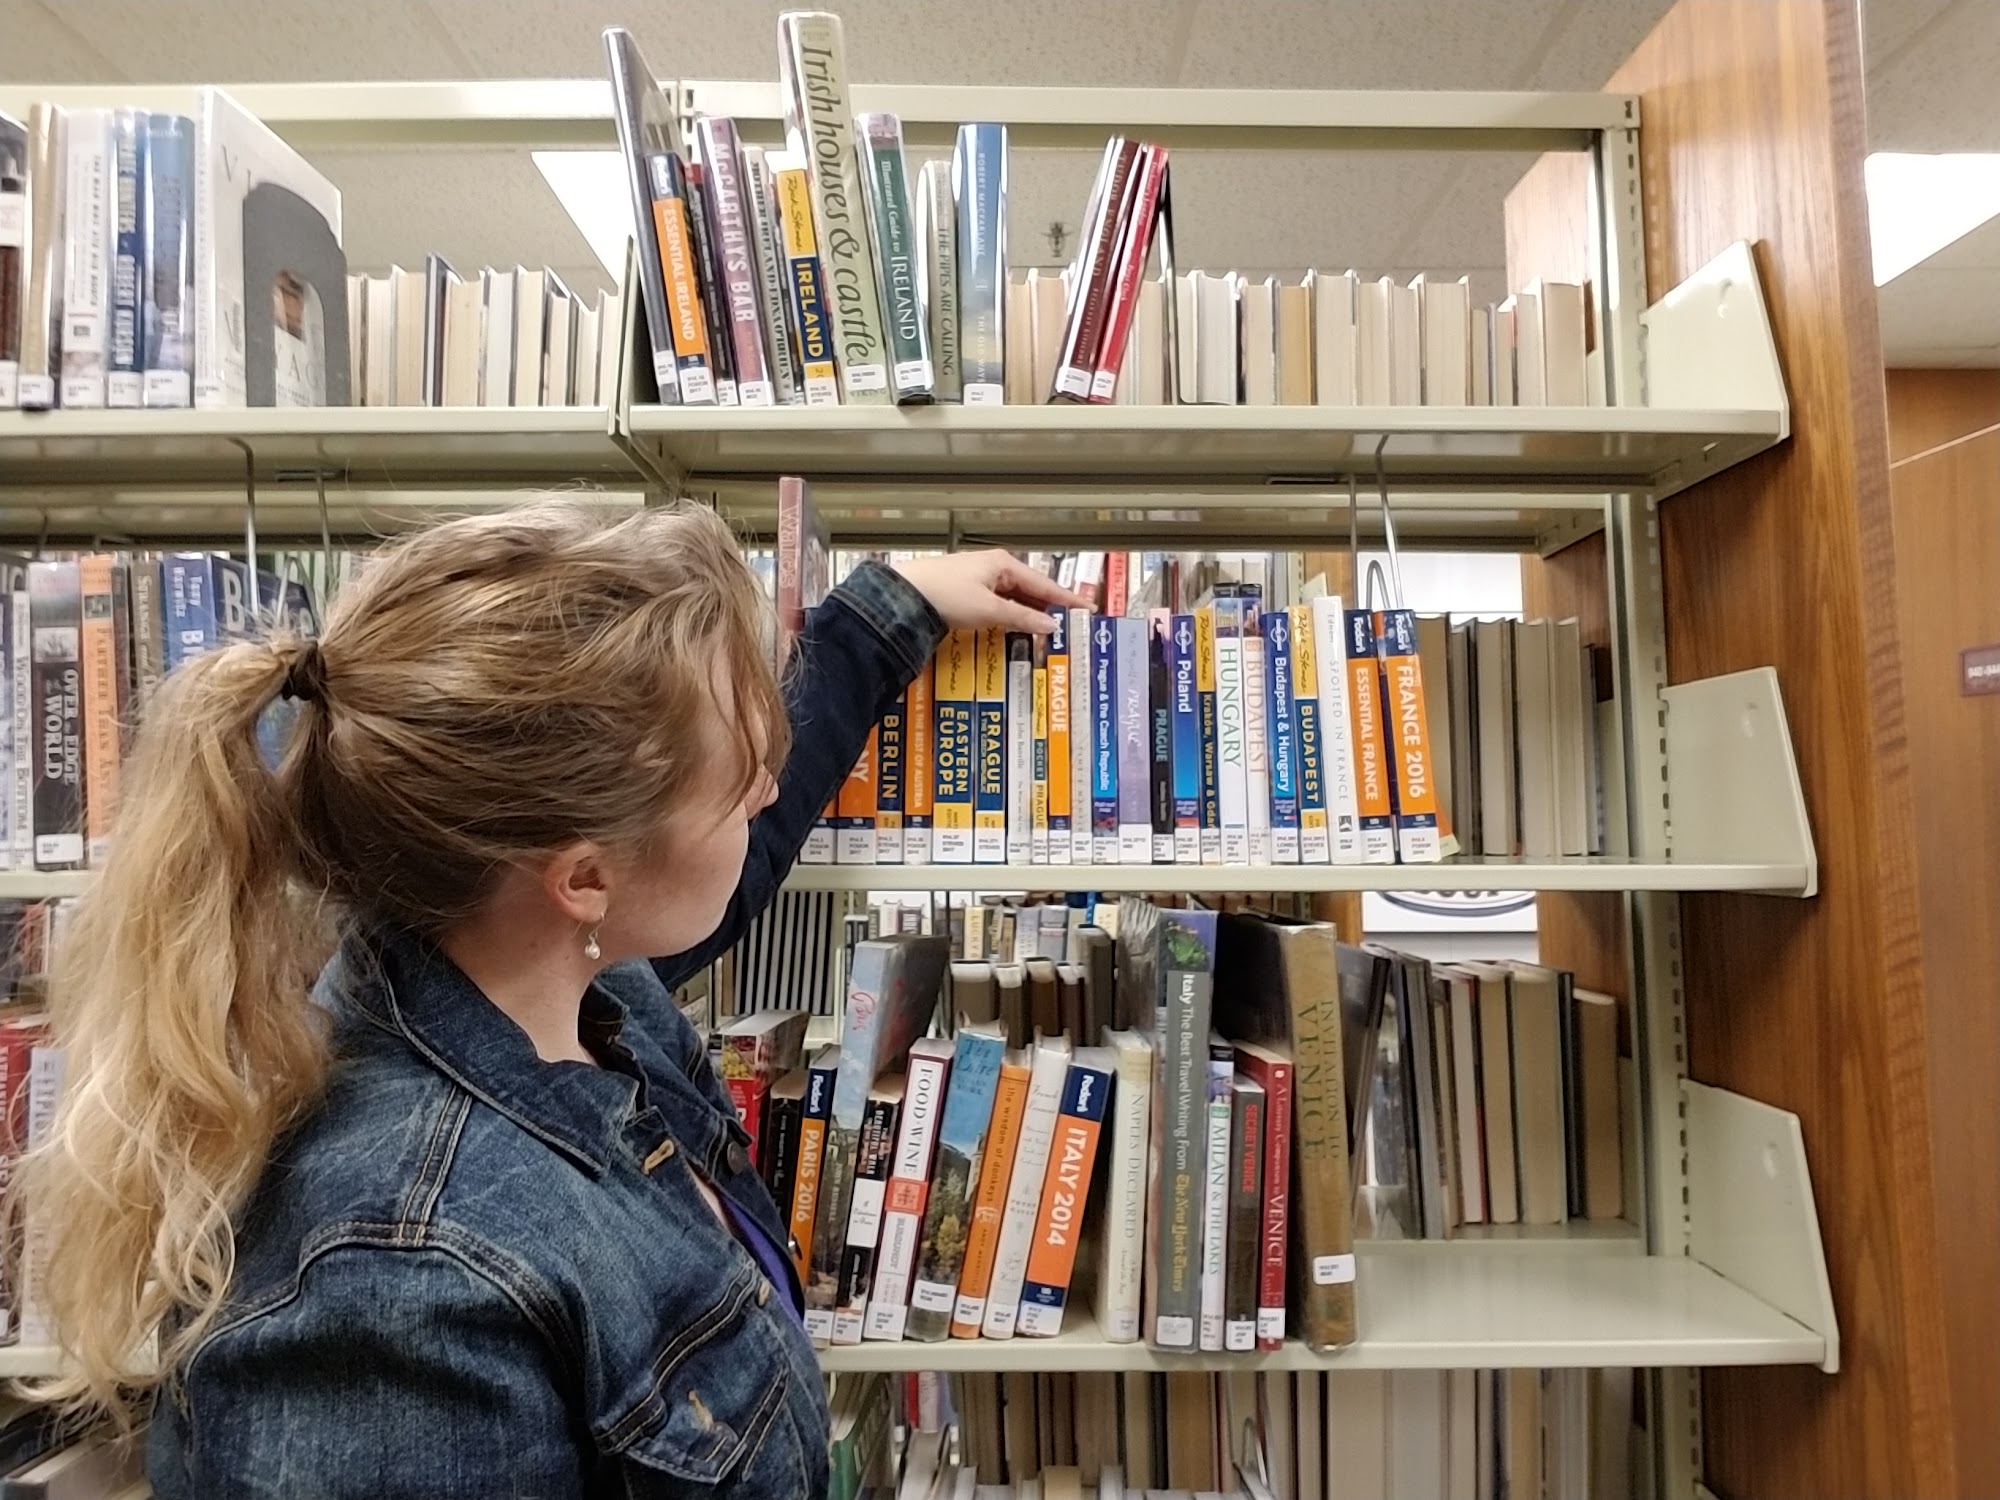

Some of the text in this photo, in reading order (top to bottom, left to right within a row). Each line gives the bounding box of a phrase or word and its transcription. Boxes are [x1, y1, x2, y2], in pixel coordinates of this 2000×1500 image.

[801, 45, 843, 113] Irish
[751, 162, 767, 218] MOTHER
[810, 119, 851, 221] houses
[977, 153, 987, 256] ROBERT MACFARLANE
[714, 142, 755, 322] McCARTHY'S BAR
[830, 229, 860, 263] &
[881, 160, 917, 340] Illustrated Guide to IRELAND
[1091, 155, 1128, 276] TUDOR ENGLAND
[664, 209, 695, 340] ESSENTIAL IRELAND
[796, 263, 822, 357] IRELAND
[938, 228, 955, 376] THE PIPES ARE CALLING
[832, 268, 876, 366] castles
[977, 315, 985, 332] THE
[977, 336, 985, 355] OLD
[977, 358, 986, 384] WAYS
[780, 504, 799, 589] Wales
[137, 575, 152, 640] STRANGE
[1199, 615, 1210, 646] Rick
[1353, 616, 1367, 652] Fodor's
[1395, 613, 1409, 651] Fodor's
[915, 714, 924, 729] THE
[1051, 665, 1067, 732] PRAGUE
[1098, 659, 1110, 790] Prague & the Czech Republic
[1177, 660, 1191, 712] Poland
[1202, 694, 1212, 738] Kraków,
[1219, 648, 1242, 768] HUNGARY
[1245, 660, 1265, 777] BUDAPEST
[1274, 657, 1290, 792] Budapest & Hungary
[44, 695, 63, 779] WORLD
[62, 670, 78, 785] OVER EDGE
[883, 714, 901, 798] BERLIN
[914, 732, 923, 752] BEST
[915, 754, 923, 767] OF
[939, 706, 954, 796] EUROPE
[956, 710, 969, 792] EASTERN
[986, 711, 1001, 794] PRAGUE
[1016, 722, 1025, 738] John
[1017, 739, 1025, 769] Banville
[1036, 742, 1044, 779] POCKET
[1155, 708, 1168, 762] PRAGUE
[1204, 742, 1215, 784] Warsaw
[1301, 705, 1319, 802] BUDAPEST
[1329, 659, 1348, 800] SPOTTED IN FRANCE
[1355, 667, 1379, 801] ESSENTIAL FRANCE
[1397, 665, 1425, 799] FRANCE 2016
[913, 769, 923, 807] AUSTRIA
[1036, 784, 1045, 828] PRAGUE
[1206, 789, 1215, 797] &
[808, 1074, 826, 1113] Fodor's
[904, 1067, 935, 1174] FOOD WINE
[1075, 1074, 1096, 1113] Fodor's
[1274, 1097, 1286, 1131] Literary
[1275, 1084, 1287, 1095] A
[1298, 1004, 1325, 1161] VENICE
[1320, 1000, 1341, 1159] INVITATION TO
[866, 1110, 884, 1174] BEAUTIFUL WALK
[985, 1086, 1016, 1203] the wisdom of donkeys
[1124, 1093, 1145, 1238] NAPLES DECLARED
[1171, 973, 1195, 1292] Italy The Best Travel Writing From The New York Times
[1242, 1104, 1258, 1193] SECRET VENICE
[1272, 1134, 1286, 1184] Companion
[795, 1129, 820, 1222] PARIS 2016
[1046, 1127, 1089, 1246] ITALY 2014
[1209, 1124, 1227, 1276] MILAN & THE LAKES
[889, 1217, 906, 1268] BURGUNDY
[1267, 1194, 1285, 1267] VENICE
